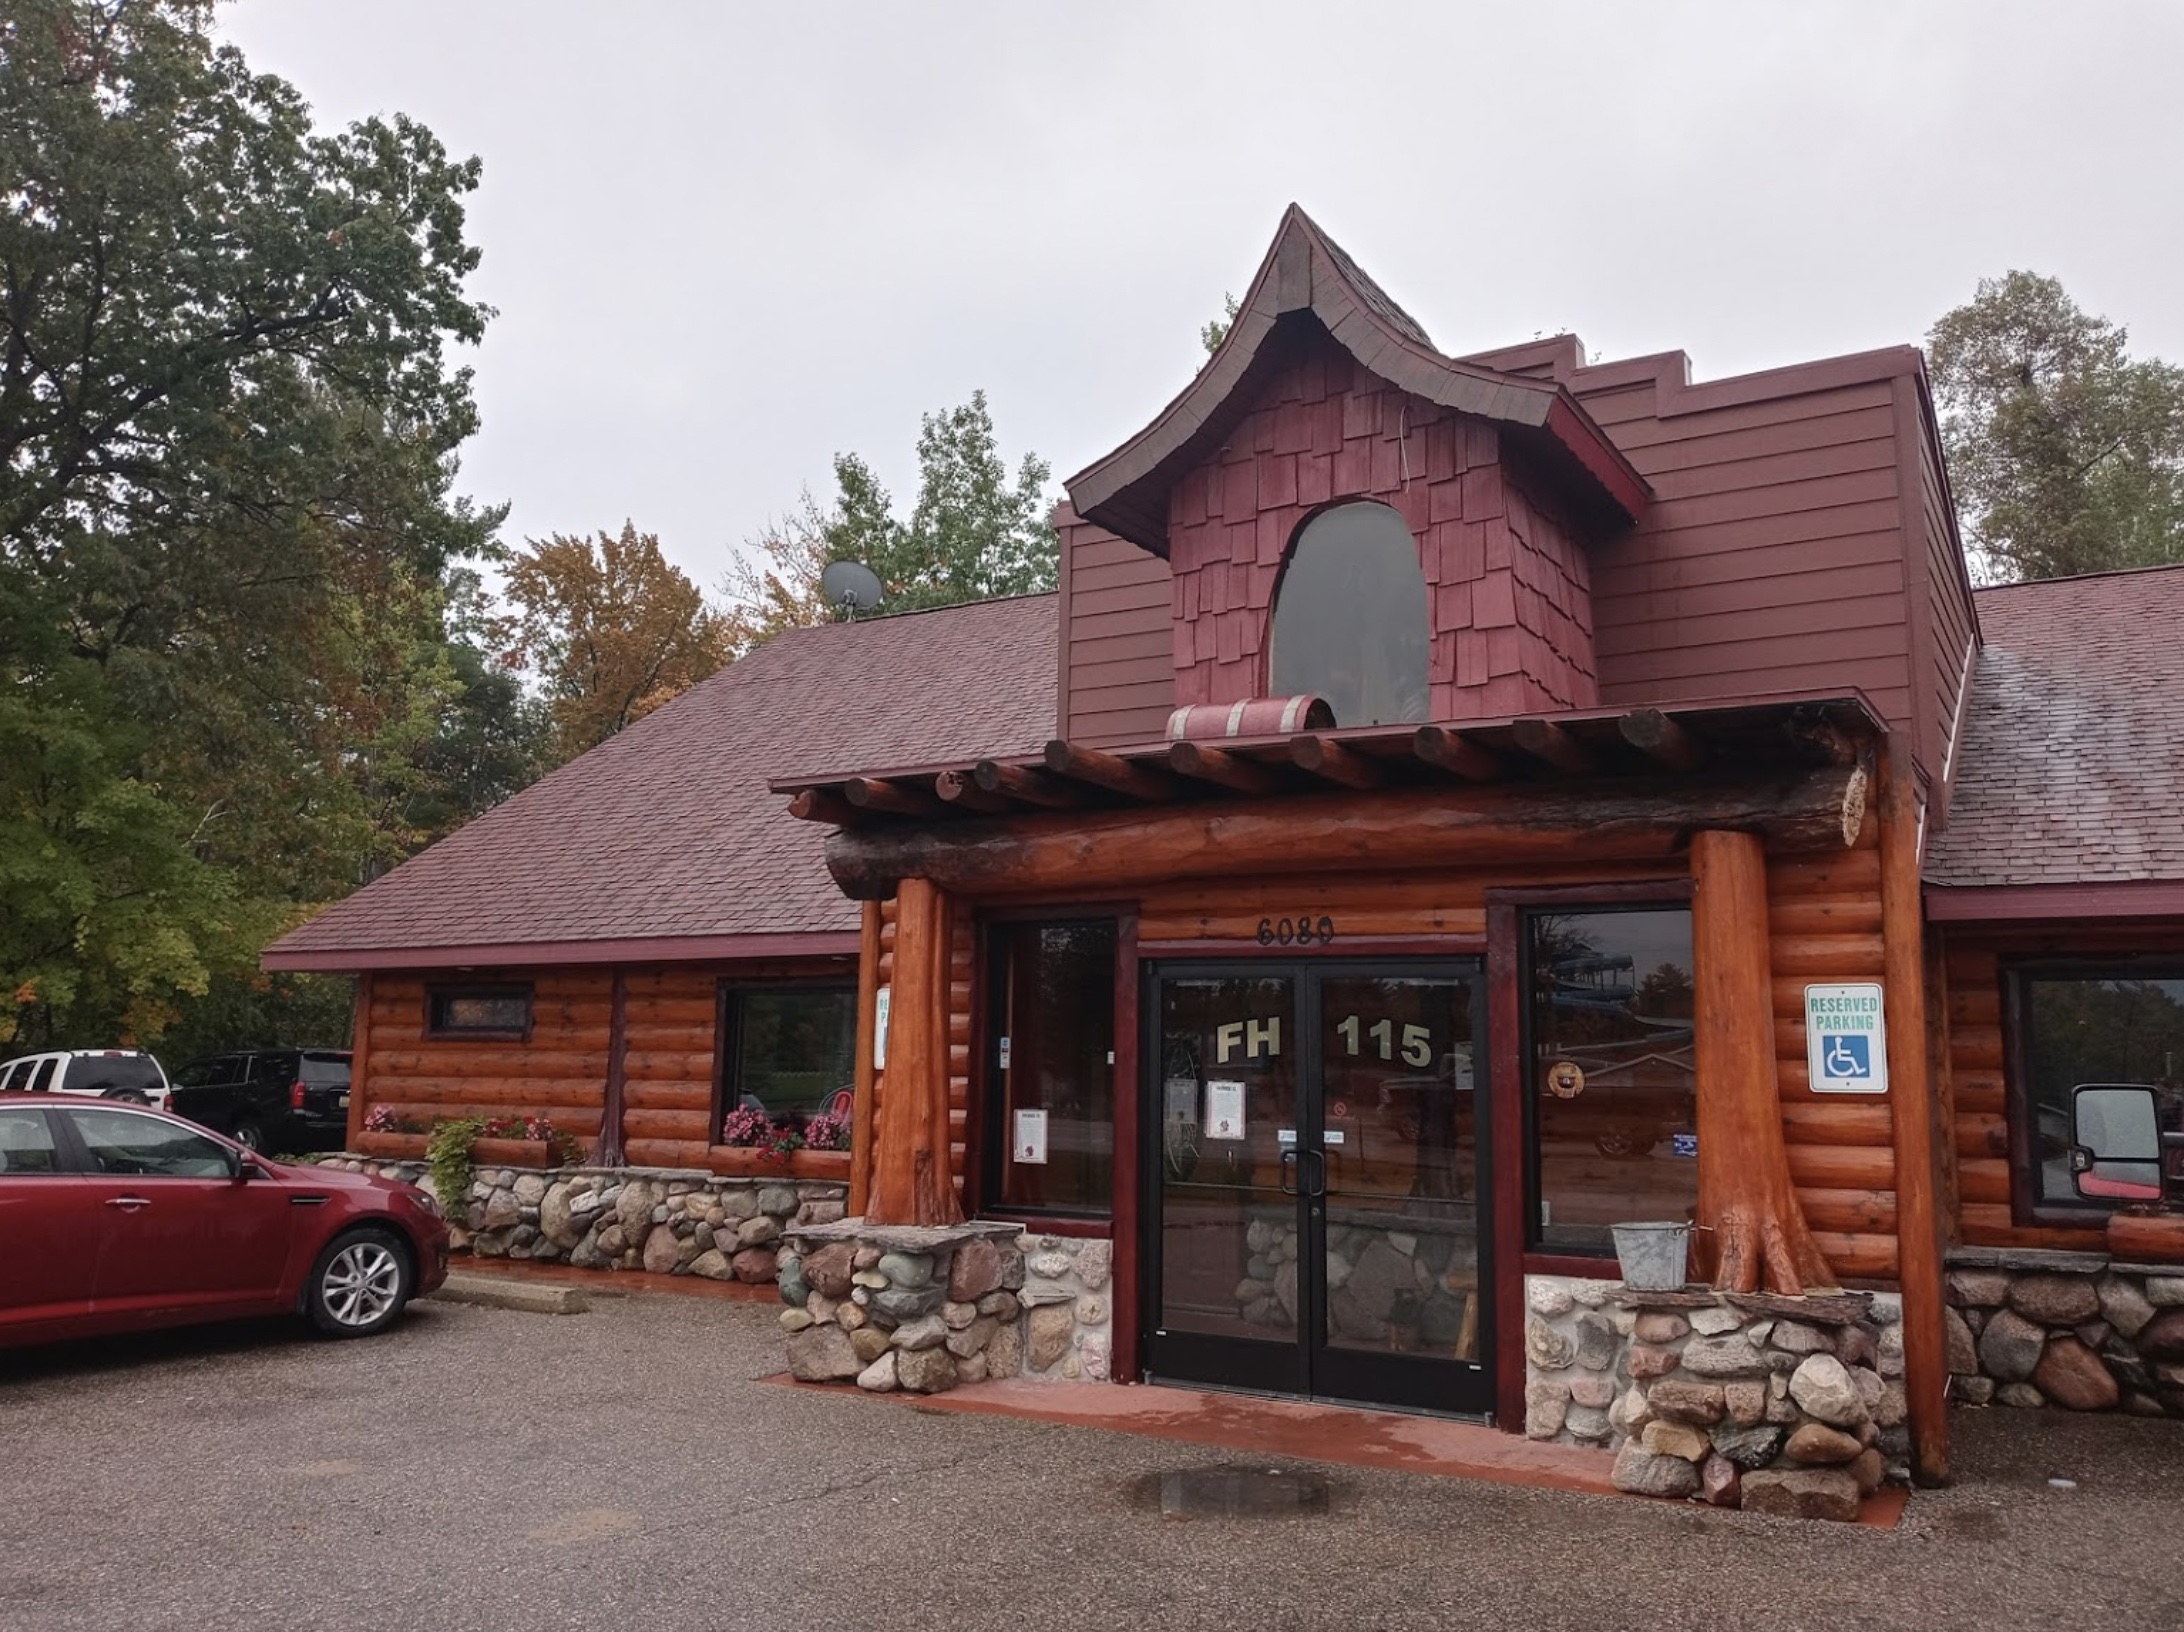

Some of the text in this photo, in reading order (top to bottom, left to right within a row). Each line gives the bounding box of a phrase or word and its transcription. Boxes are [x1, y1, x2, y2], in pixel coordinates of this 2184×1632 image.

[1257, 916, 1334, 945] 6080
[1810, 997, 1878, 1012] RESERVED
[1816, 1015, 1874, 1030] PARKING
[1217, 1015, 1432, 1067] FH 115
